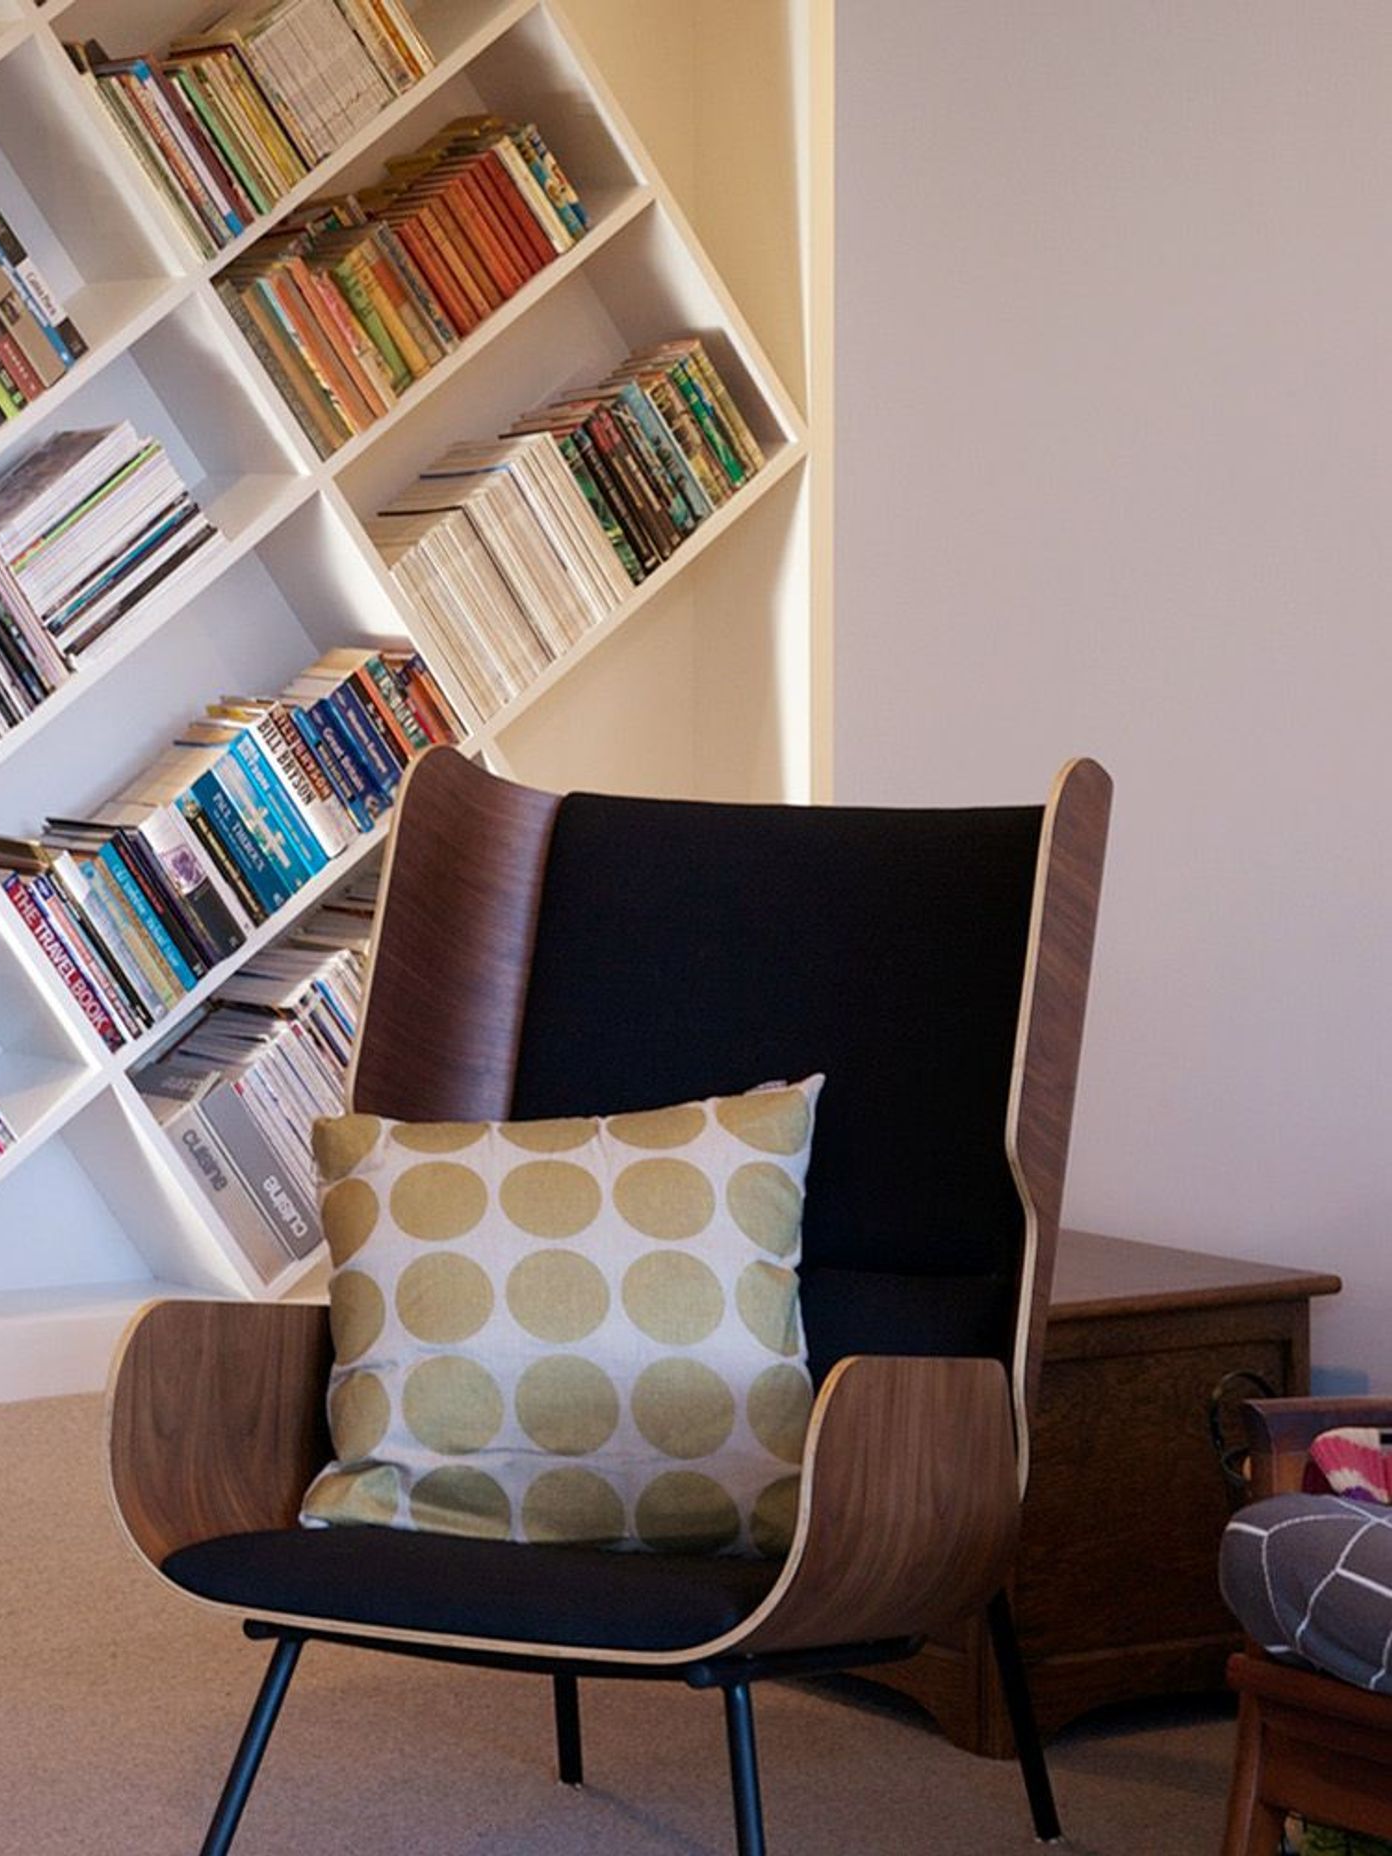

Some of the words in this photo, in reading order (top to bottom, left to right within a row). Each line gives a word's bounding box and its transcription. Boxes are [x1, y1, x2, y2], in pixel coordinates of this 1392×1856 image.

[254, 718, 286, 755] BILL
[274, 750, 319, 807] BRYSON
[10, 886, 41, 924] THE
[30, 918, 81, 986] TRAVEL
[69, 977, 111, 1031] BOOK
[179, 1125, 234, 1194] cuisine
[259, 1172, 312, 1241] cuisine
